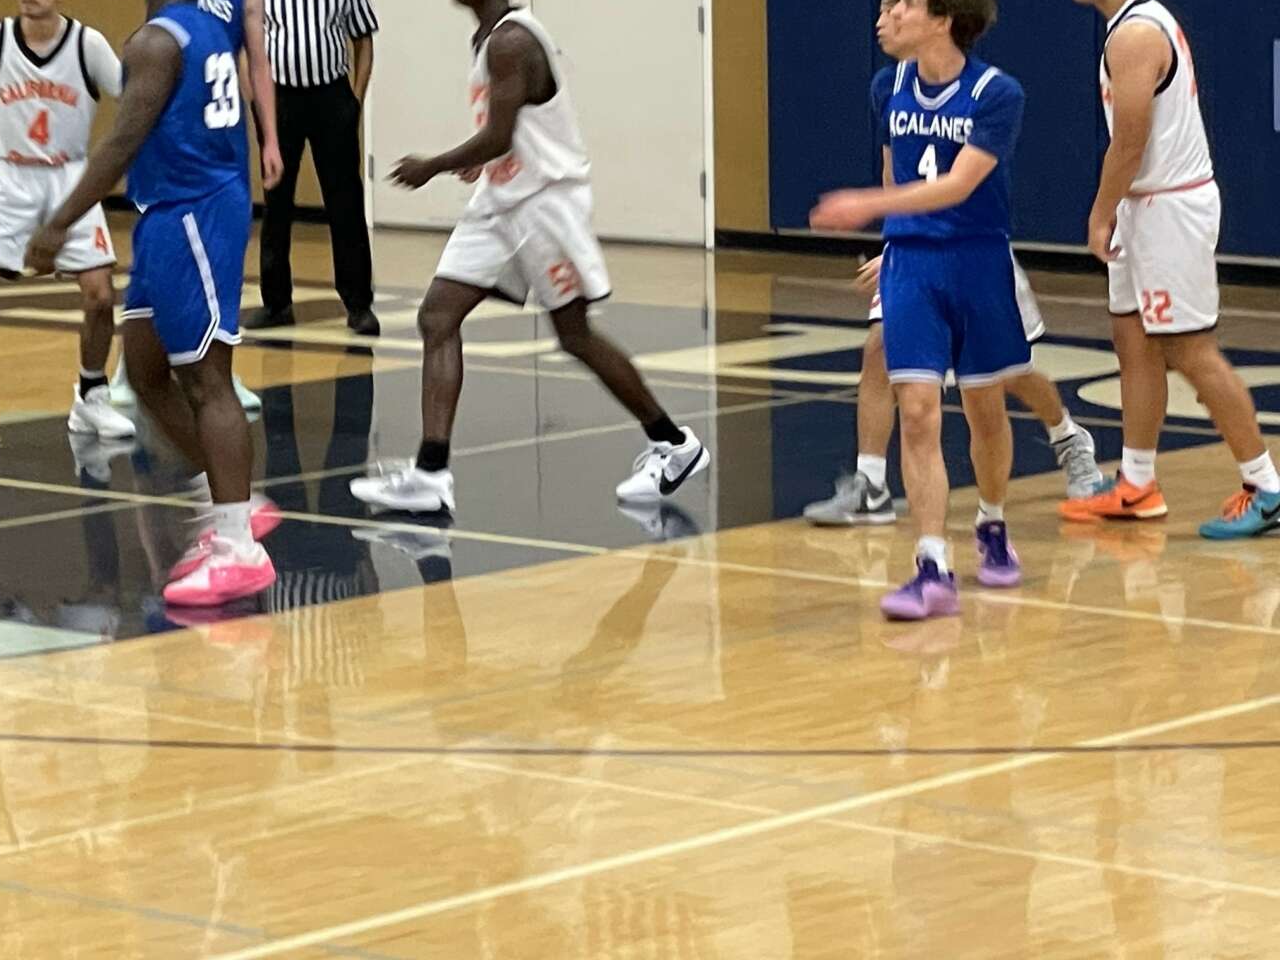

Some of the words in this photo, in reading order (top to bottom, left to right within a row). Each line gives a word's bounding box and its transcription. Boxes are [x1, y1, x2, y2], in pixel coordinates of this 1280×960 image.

[203, 51, 241, 130] 33
[28, 110, 49, 145] 4
[889, 109, 974, 145] ACALANES
[917, 143, 938, 184] 4
